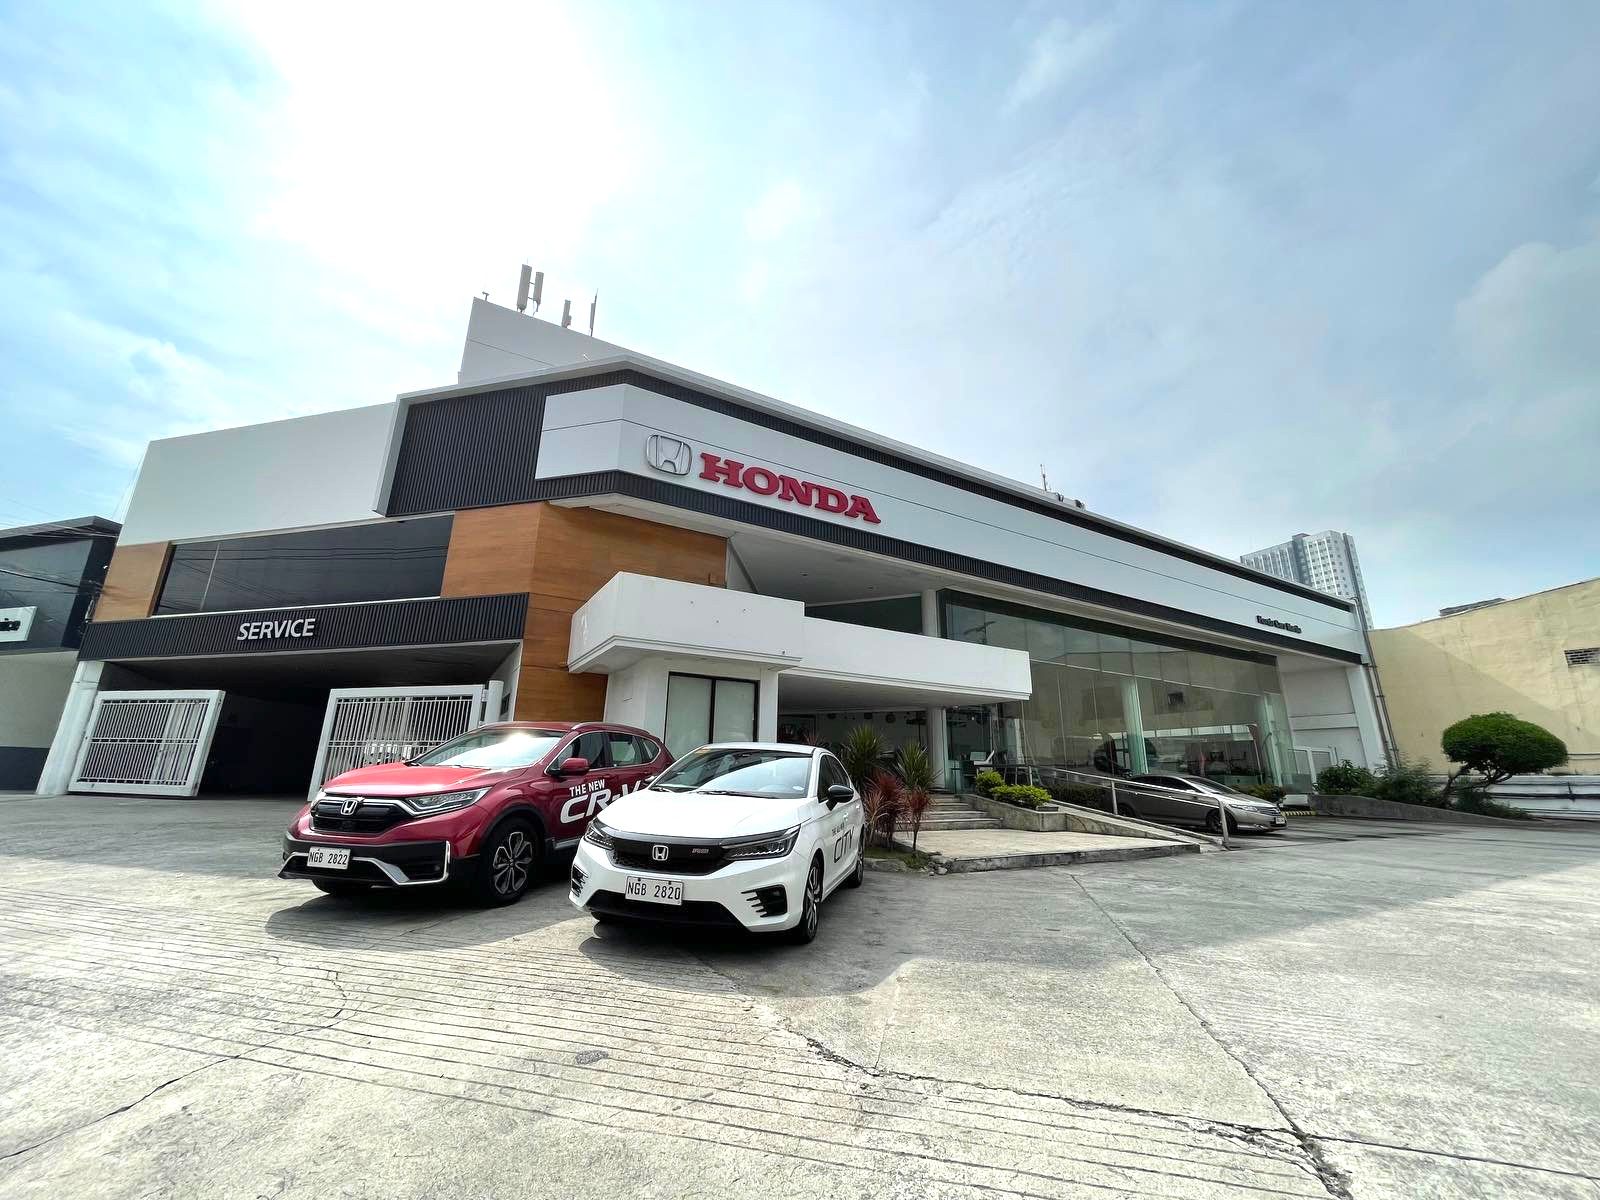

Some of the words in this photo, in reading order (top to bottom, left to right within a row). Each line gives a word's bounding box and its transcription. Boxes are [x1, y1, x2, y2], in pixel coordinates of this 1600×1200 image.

[699, 452, 882, 525] HONDA
[236, 618, 316, 641] SERVICE
[569, 784, 587, 797] THE
[588, 779, 605, 792] NEW
[308, 851, 324, 863] NGB
[327, 853, 348, 866] 2822
[627, 881, 647, 896] NGB
[653, 884, 681, 900] 2820
